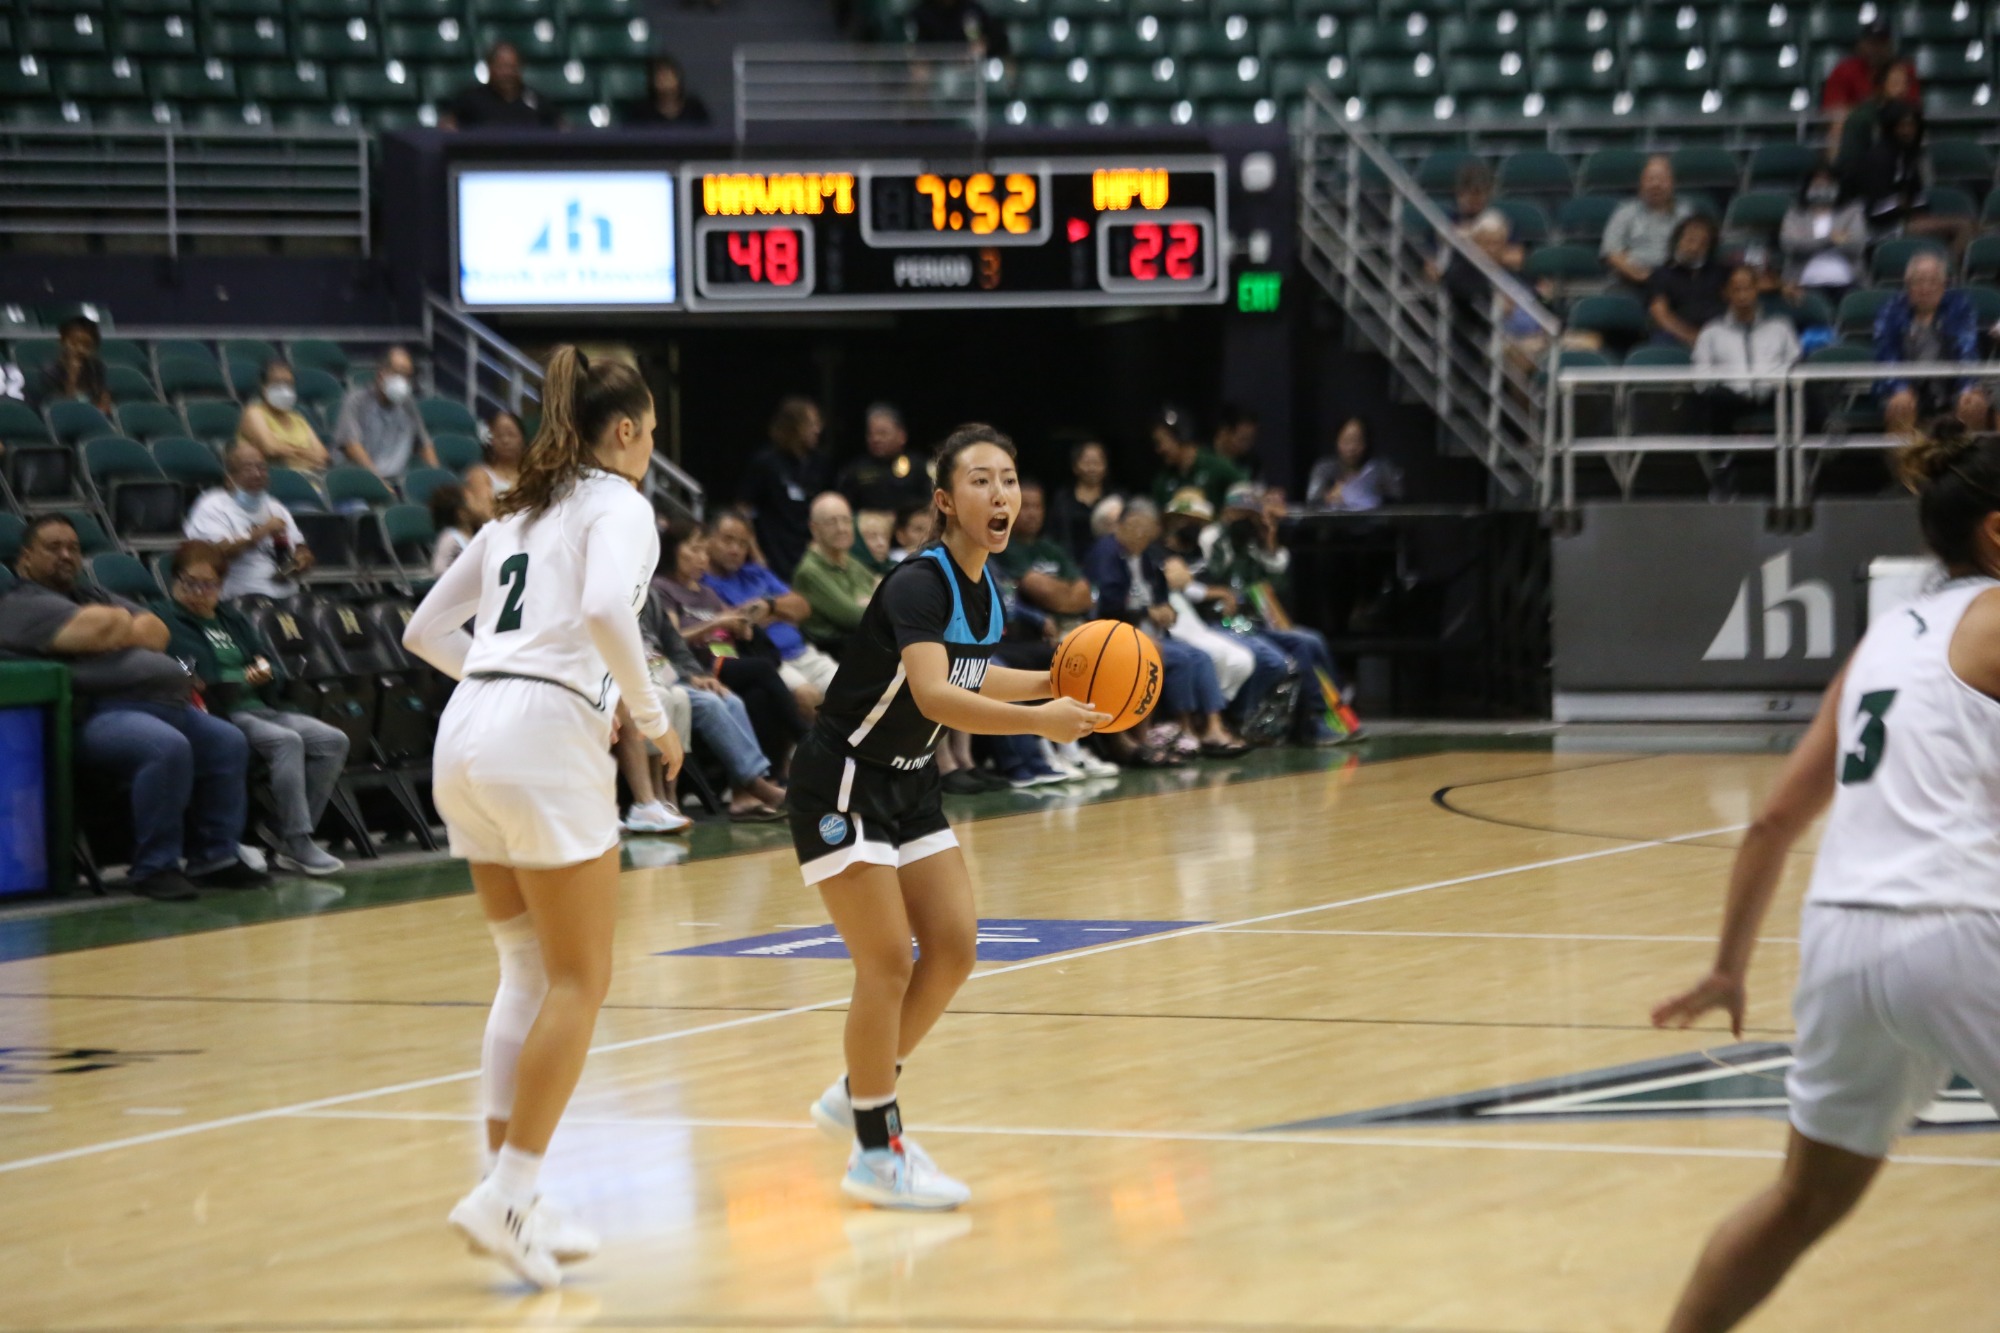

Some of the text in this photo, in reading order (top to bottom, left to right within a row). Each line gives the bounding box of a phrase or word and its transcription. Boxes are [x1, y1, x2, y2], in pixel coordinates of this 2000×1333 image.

[915, 173, 1036, 234] 7:52
[728, 226, 798, 285] 48
[893, 254, 972, 288] PERIOD
[1130, 221, 1198, 280] 22
[495, 552, 529, 634] 2
[1134, 661, 1159, 716] NCAA
[1842, 688, 1900, 785] 3
